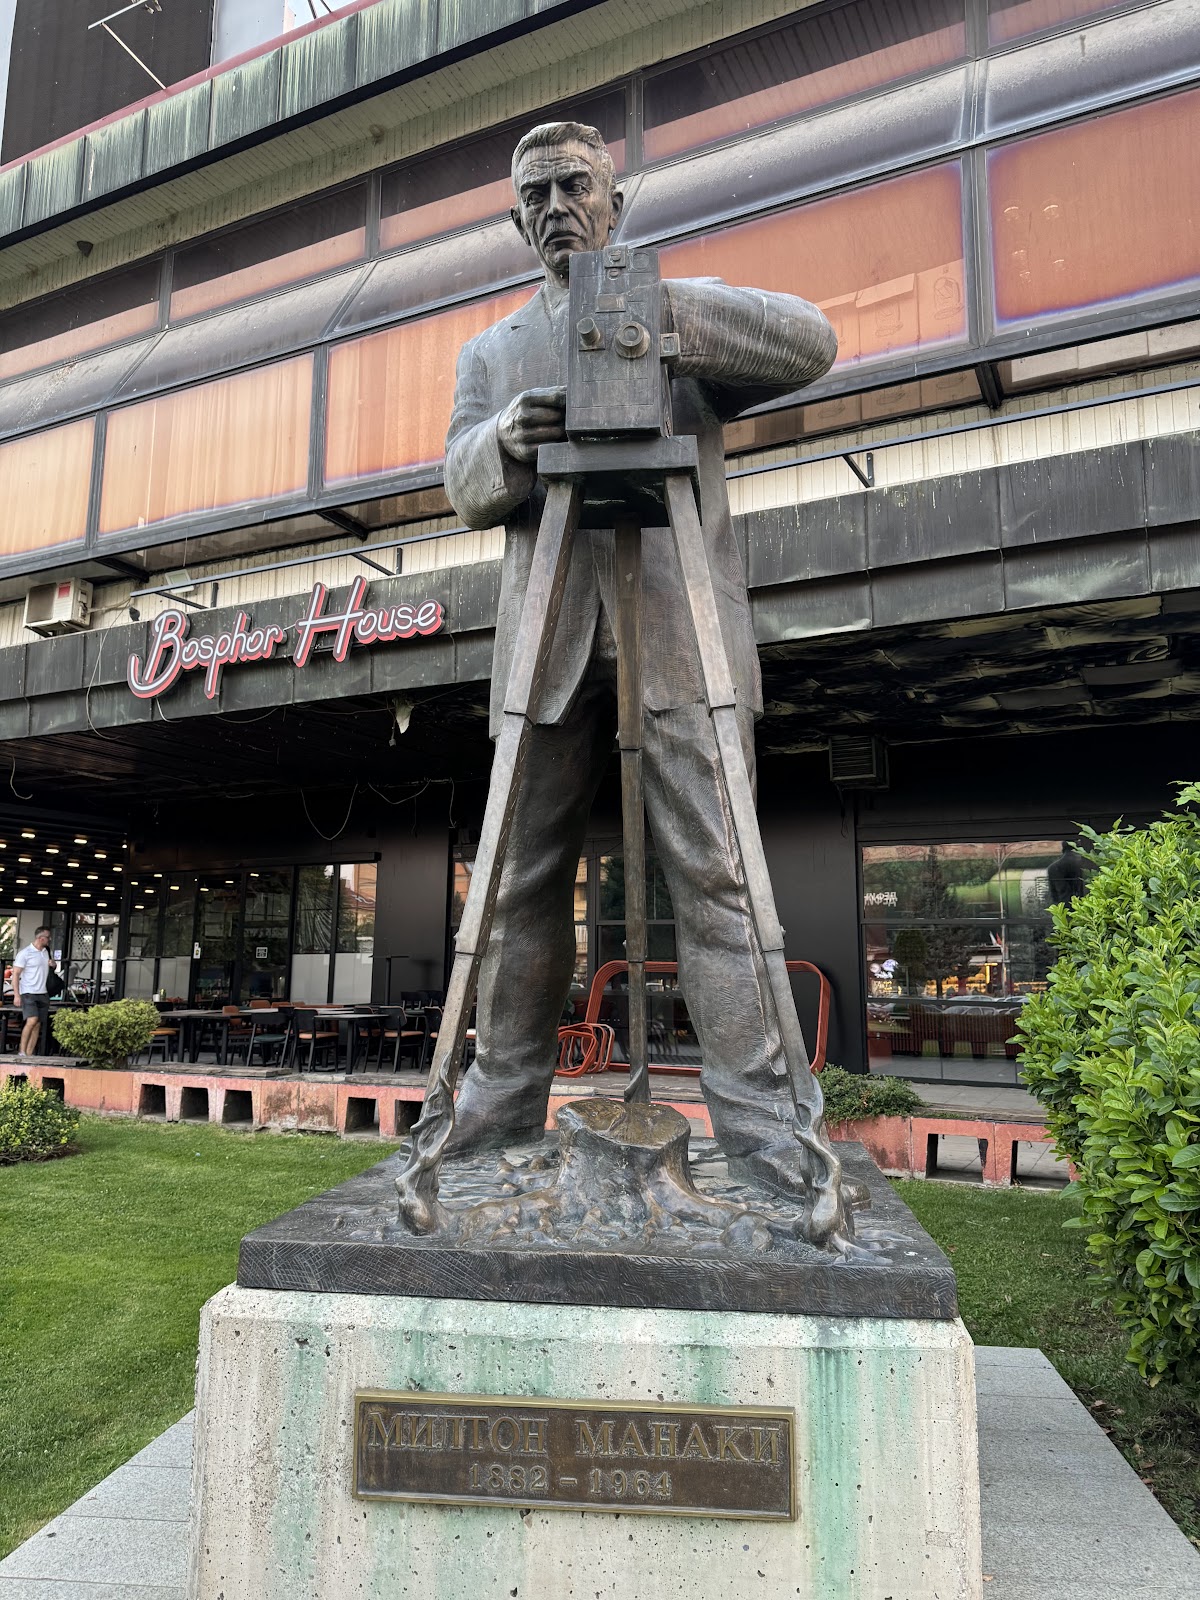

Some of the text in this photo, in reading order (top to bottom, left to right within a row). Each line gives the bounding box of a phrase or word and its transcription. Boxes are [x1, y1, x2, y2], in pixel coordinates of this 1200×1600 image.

[128, 576, 446, 699] Bosphor House
[368, 1412, 780, 1466] МИЛТОН МАНАКИ
[469, 1463, 547, 1492] 1882
[590, 1468, 672, 1497] 1964
